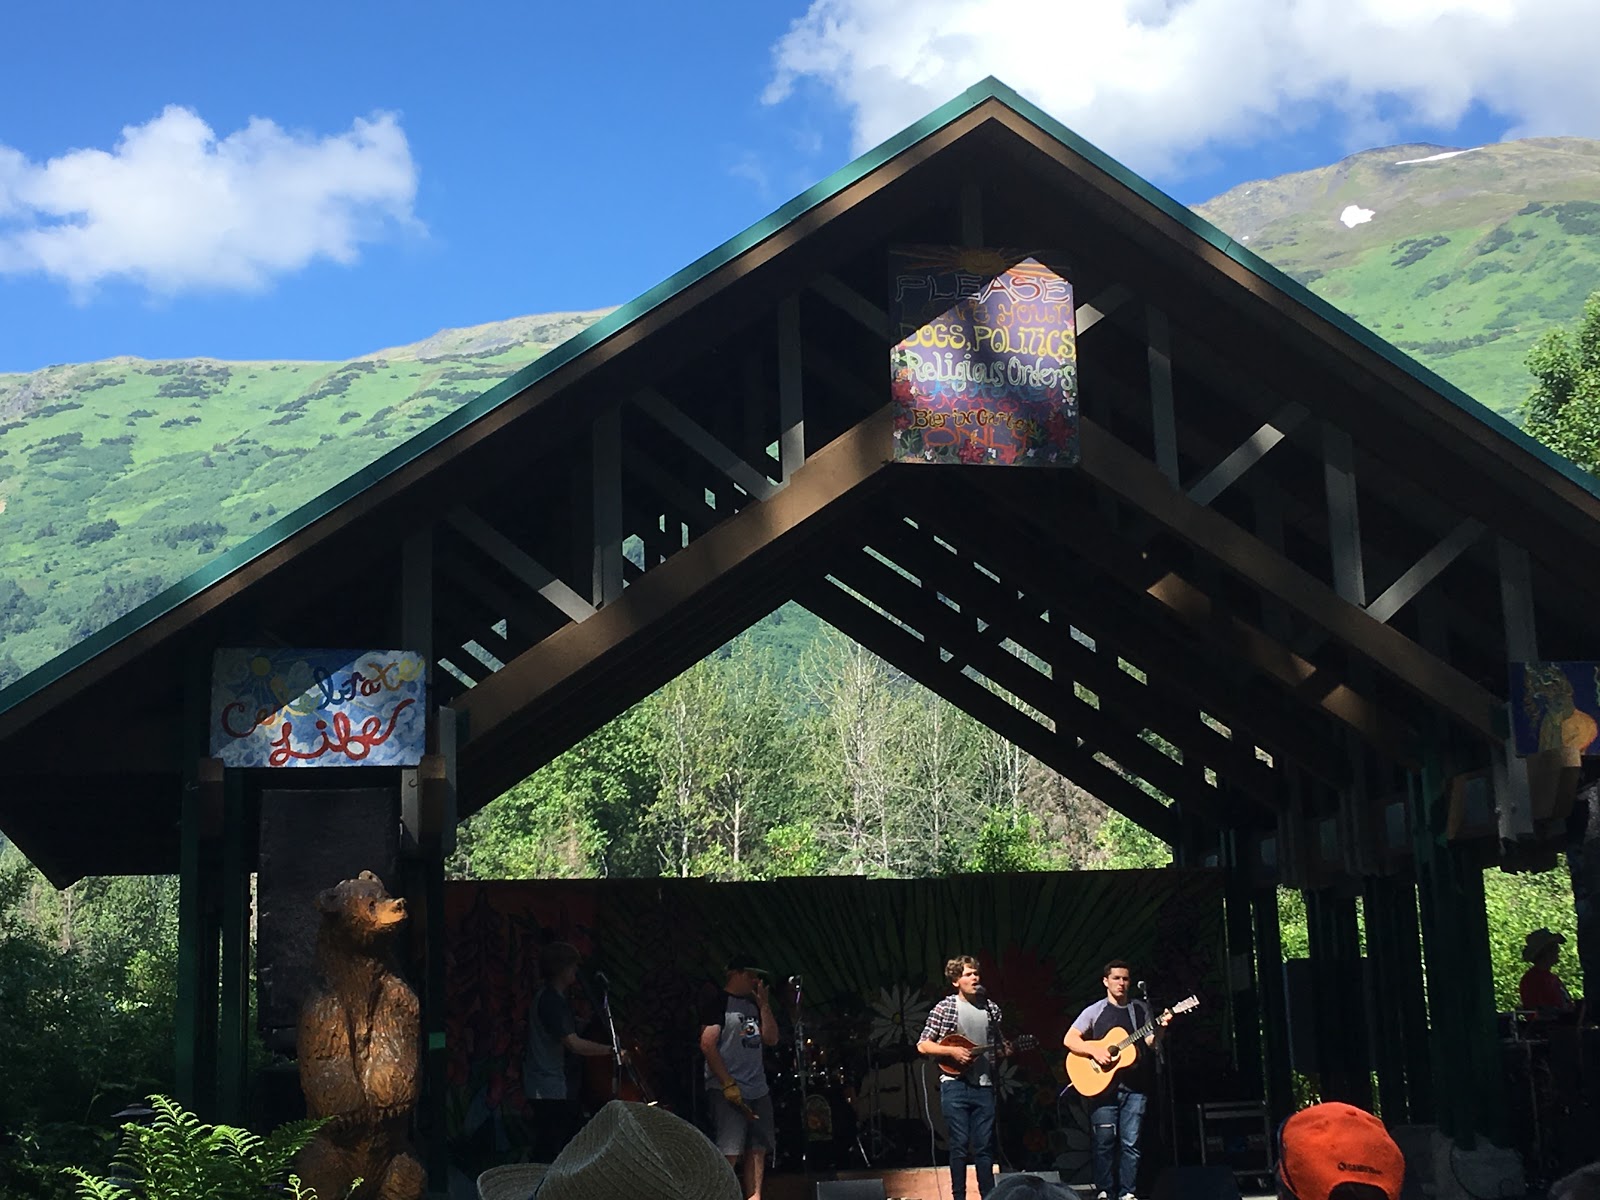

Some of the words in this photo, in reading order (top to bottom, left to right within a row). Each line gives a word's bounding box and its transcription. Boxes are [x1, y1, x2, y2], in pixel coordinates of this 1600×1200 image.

[896, 274, 1070, 304] PLEASE
[997, 303, 1071, 328] your
[899, 324, 971, 351] DOGS,
[906, 350, 1005, 391] Religious
[1007, 356, 1076, 390] Orders
[925, 425, 1029, 456] ONLY
[269, 698, 416, 767] Life
